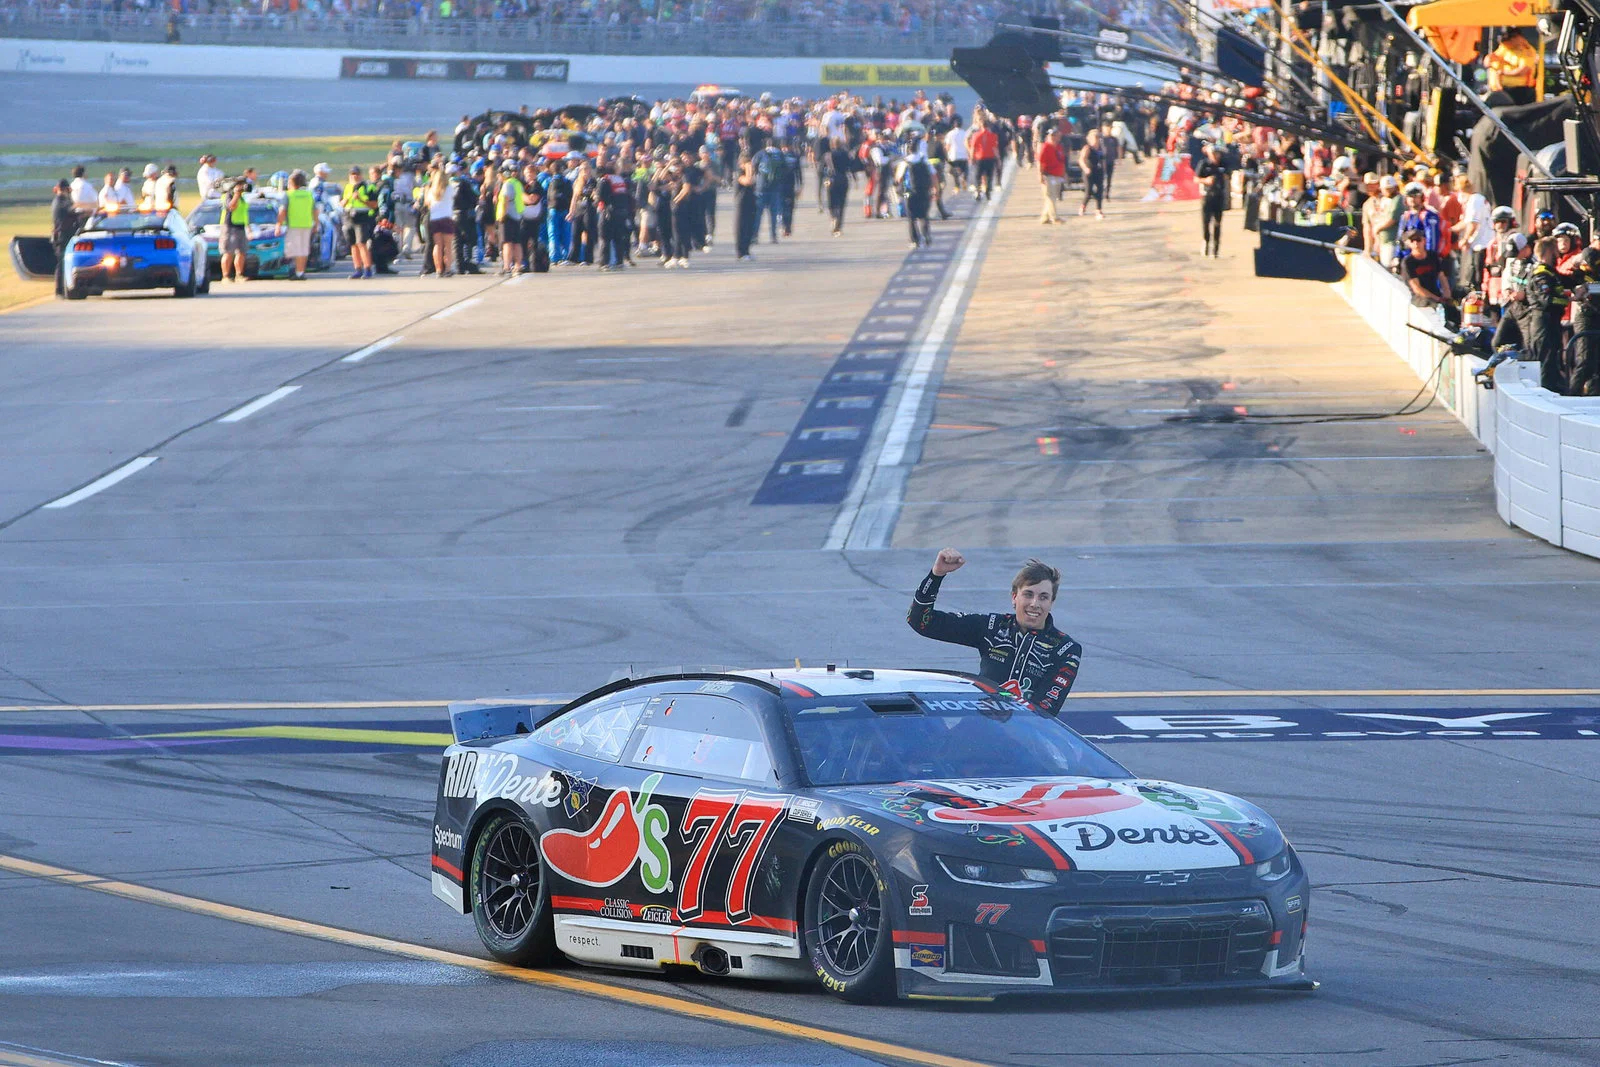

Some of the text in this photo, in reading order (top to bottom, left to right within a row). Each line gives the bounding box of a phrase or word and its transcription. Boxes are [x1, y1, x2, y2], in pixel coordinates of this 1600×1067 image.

[922, 700, 1032, 711] HOCEVAR
[443, 751, 489, 799] RIDE
[488, 752, 562, 808] 'Dente
[816, 815, 880, 836] GOODYEAR
[1049, 820, 1219, 851] 'Dente
[434, 824, 463, 850] Spectrum
[677, 786, 795, 926] 77
[600, 906, 633, 919] COLLISION
[604, 897, 630, 909] CLASSIC
[975, 902, 1011, 925] 77
[642, 907, 672, 924] ZEIGLER
[569, 935, 601, 946] respect.
[912, 951, 943, 961] SUNOCO
[816, 966, 847, 992] EAGLE
